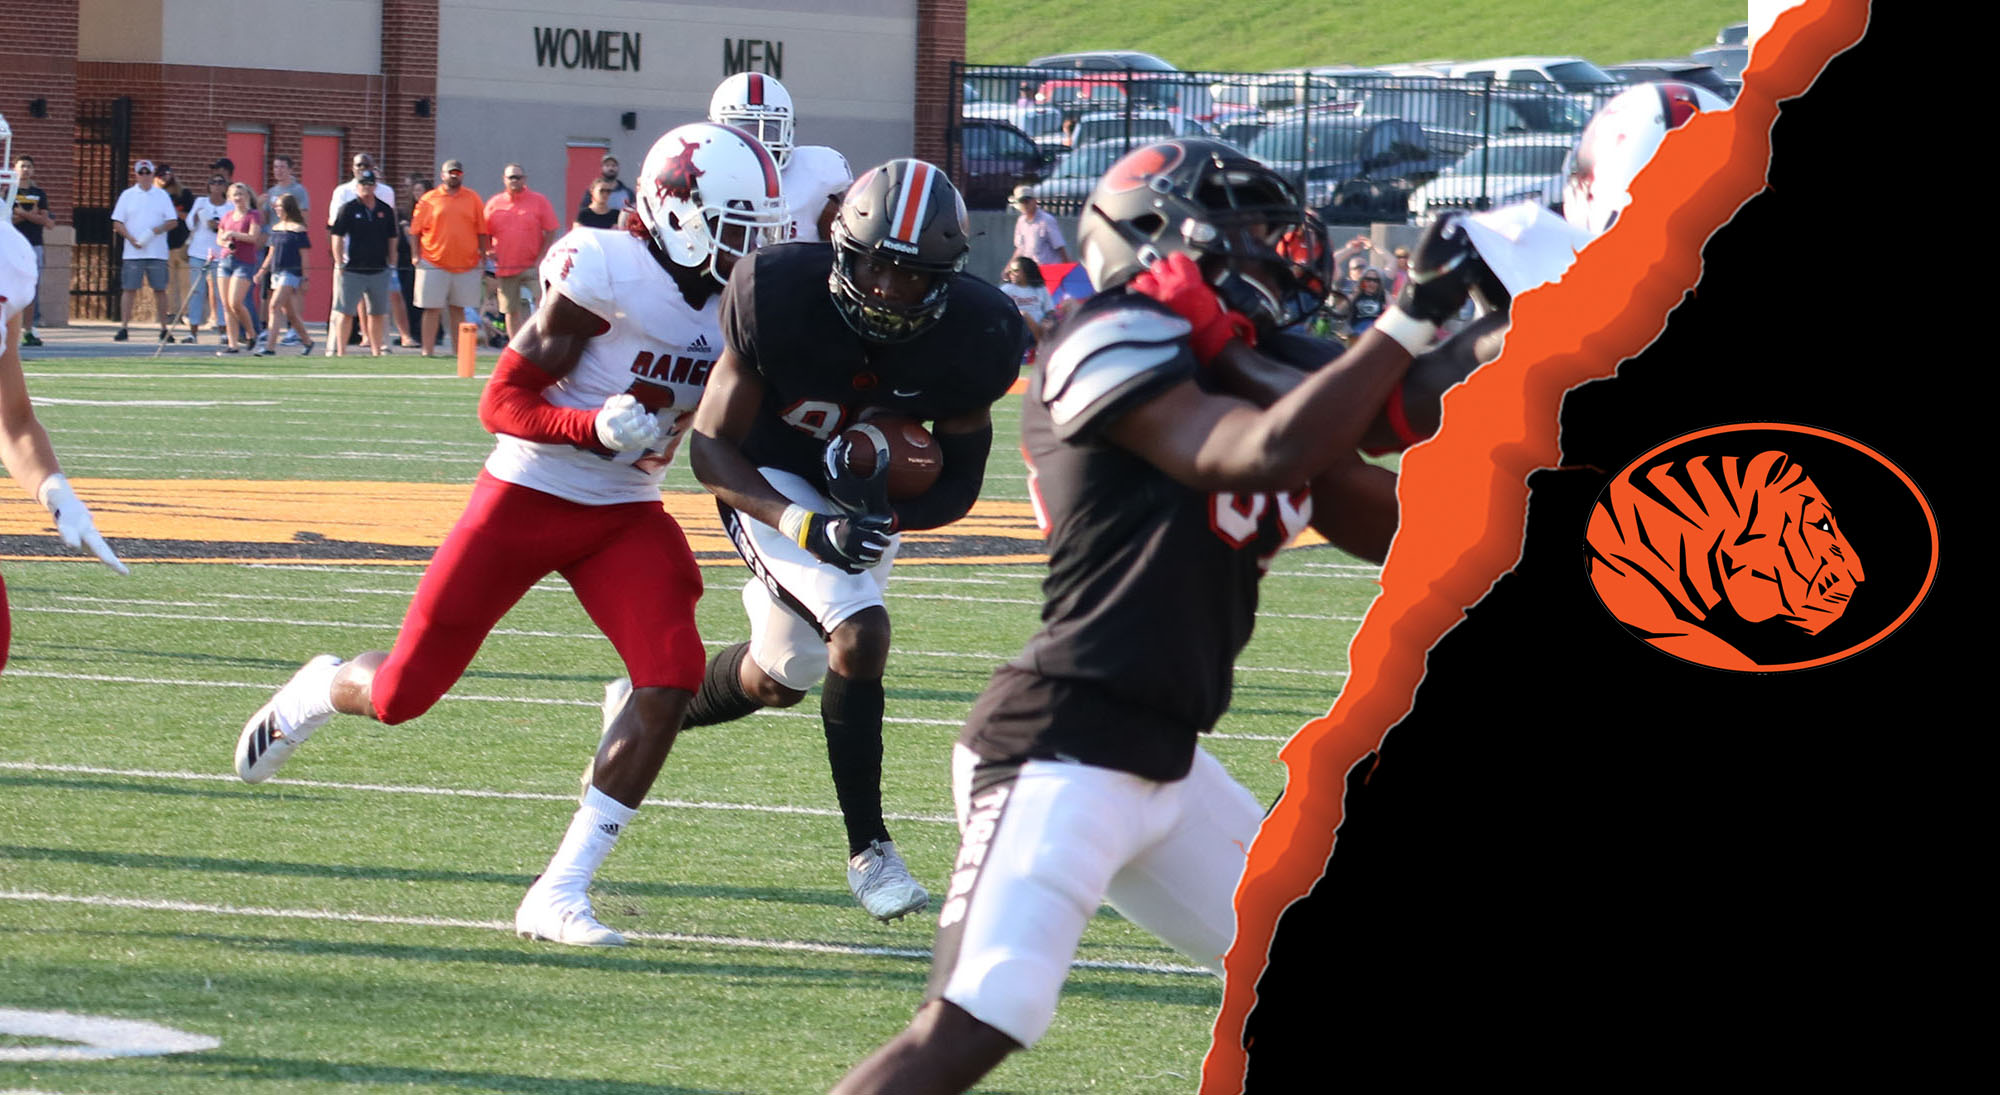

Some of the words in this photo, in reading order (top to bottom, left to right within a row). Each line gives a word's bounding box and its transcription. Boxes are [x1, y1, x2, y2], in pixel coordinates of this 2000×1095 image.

[534, 26, 641, 72] WOMEN
[723, 38, 783, 79] MEN
[730, 513, 780, 598] TIGERS
[939, 786, 1010, 928] TIGERS
